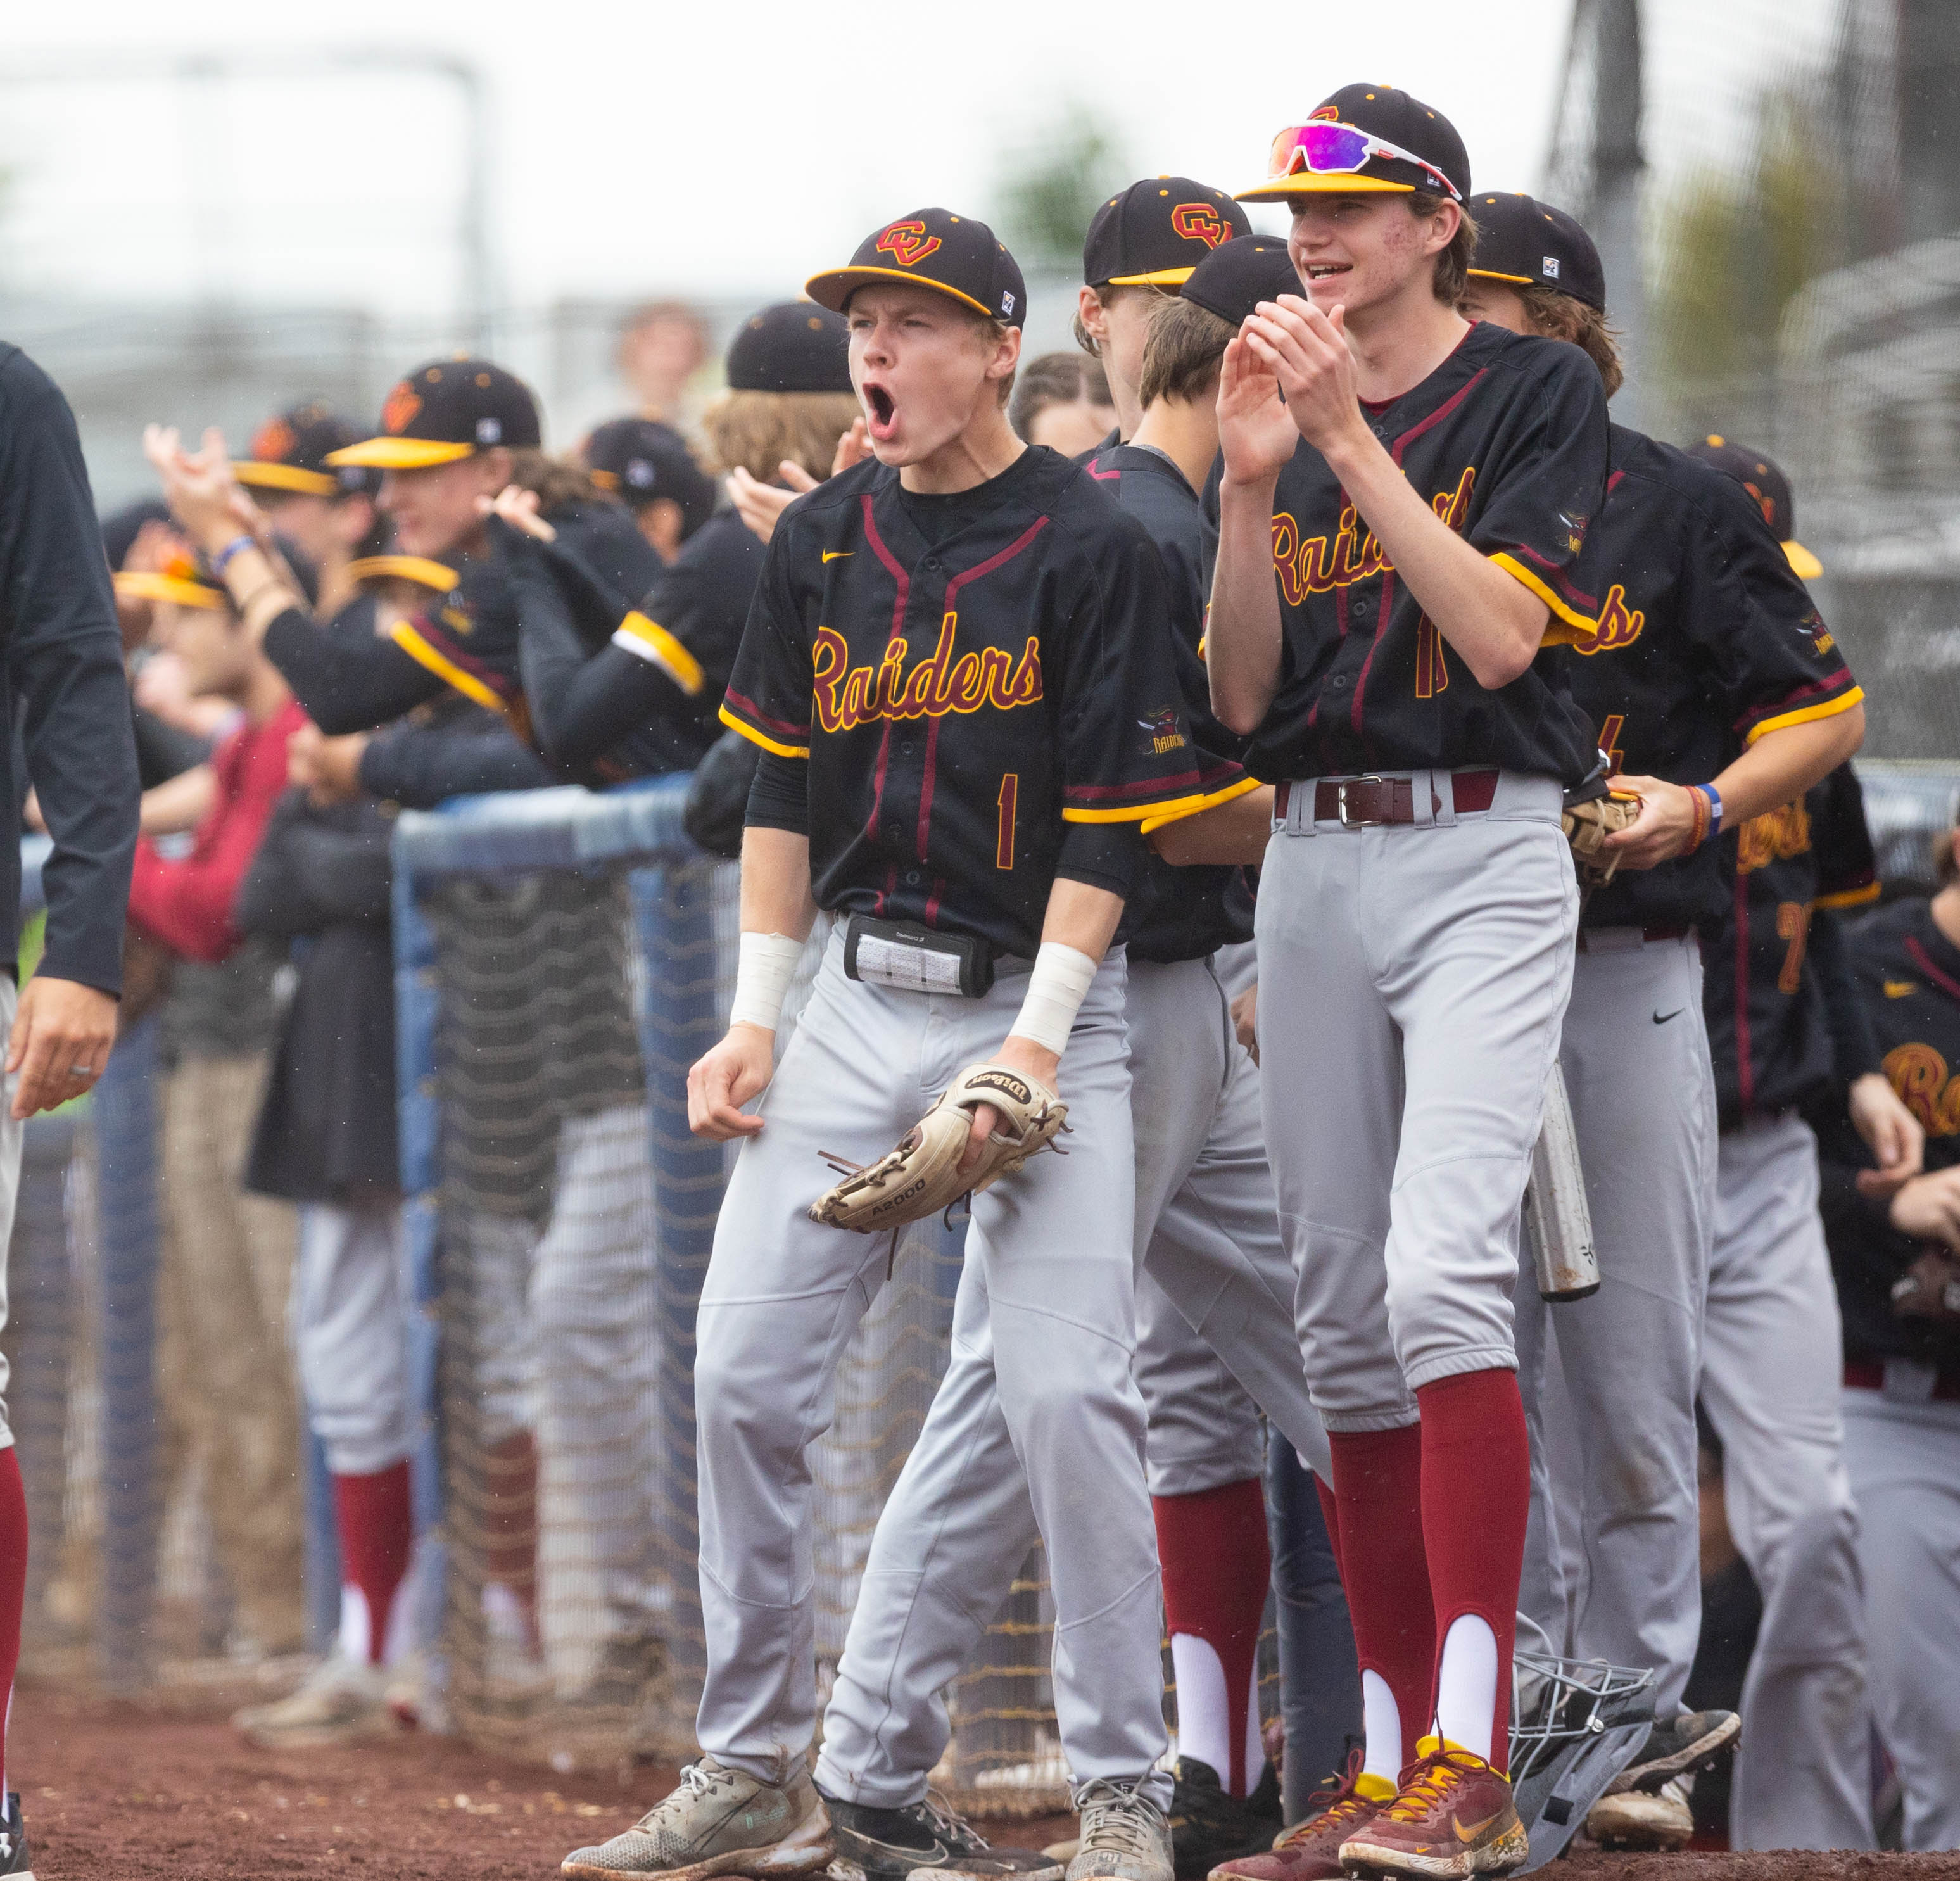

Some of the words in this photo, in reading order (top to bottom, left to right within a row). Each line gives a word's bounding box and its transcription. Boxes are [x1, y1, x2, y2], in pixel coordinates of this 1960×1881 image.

[876, 220, 942, 266] CV
[812, 612, 1043, 733] Raiders
[997, 773, 1018, 870] 1
[971, 1074, 1027, 1101] Wilson
[872, 1179, 926, 1217] A2000
